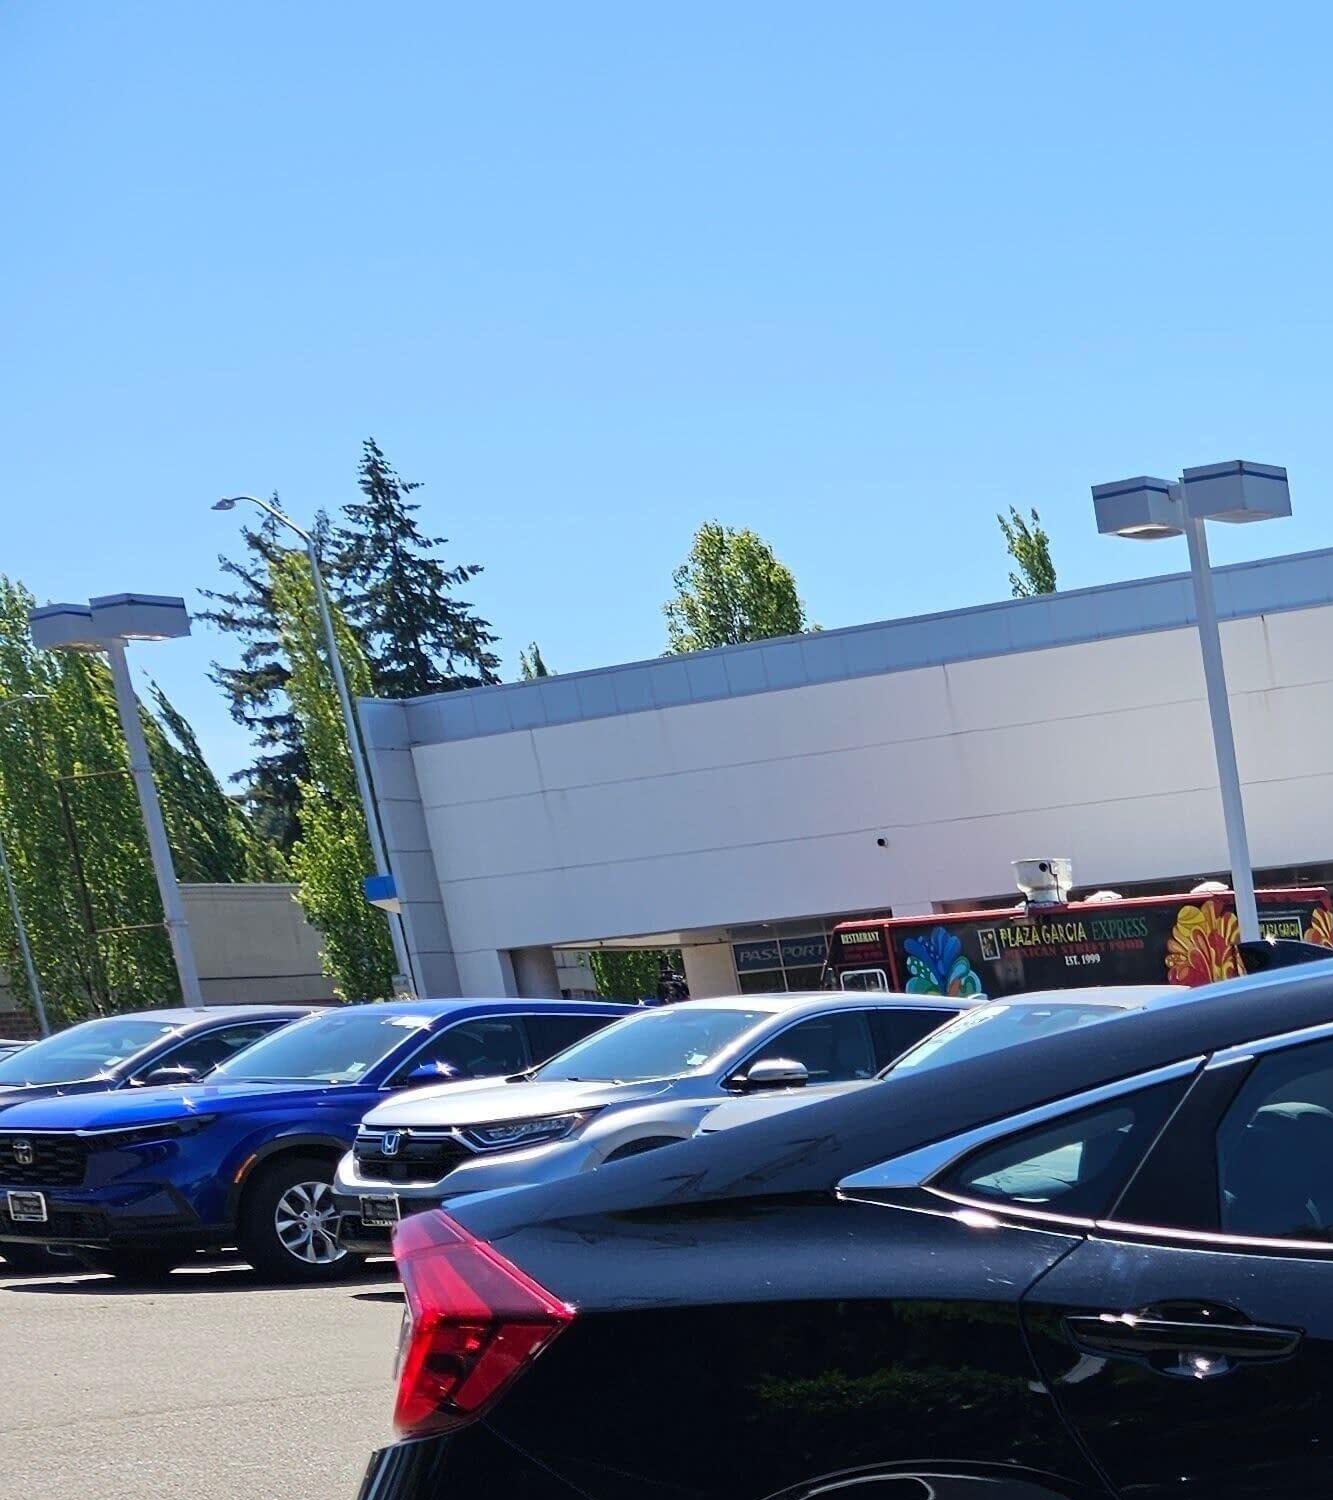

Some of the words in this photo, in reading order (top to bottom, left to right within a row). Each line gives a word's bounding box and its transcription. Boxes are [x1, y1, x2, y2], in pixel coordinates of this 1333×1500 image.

[999, 926, 1040, 949] PLAZA
[1041, 922, 1087, 944] GARCIA
[1091, 917, 1148, 941] EXPRESS
[739, 943, 826, 963] PASSPORT
[1064, 954, 1081, 966] EST.
[1082, 953, 1101, 965] 1999
